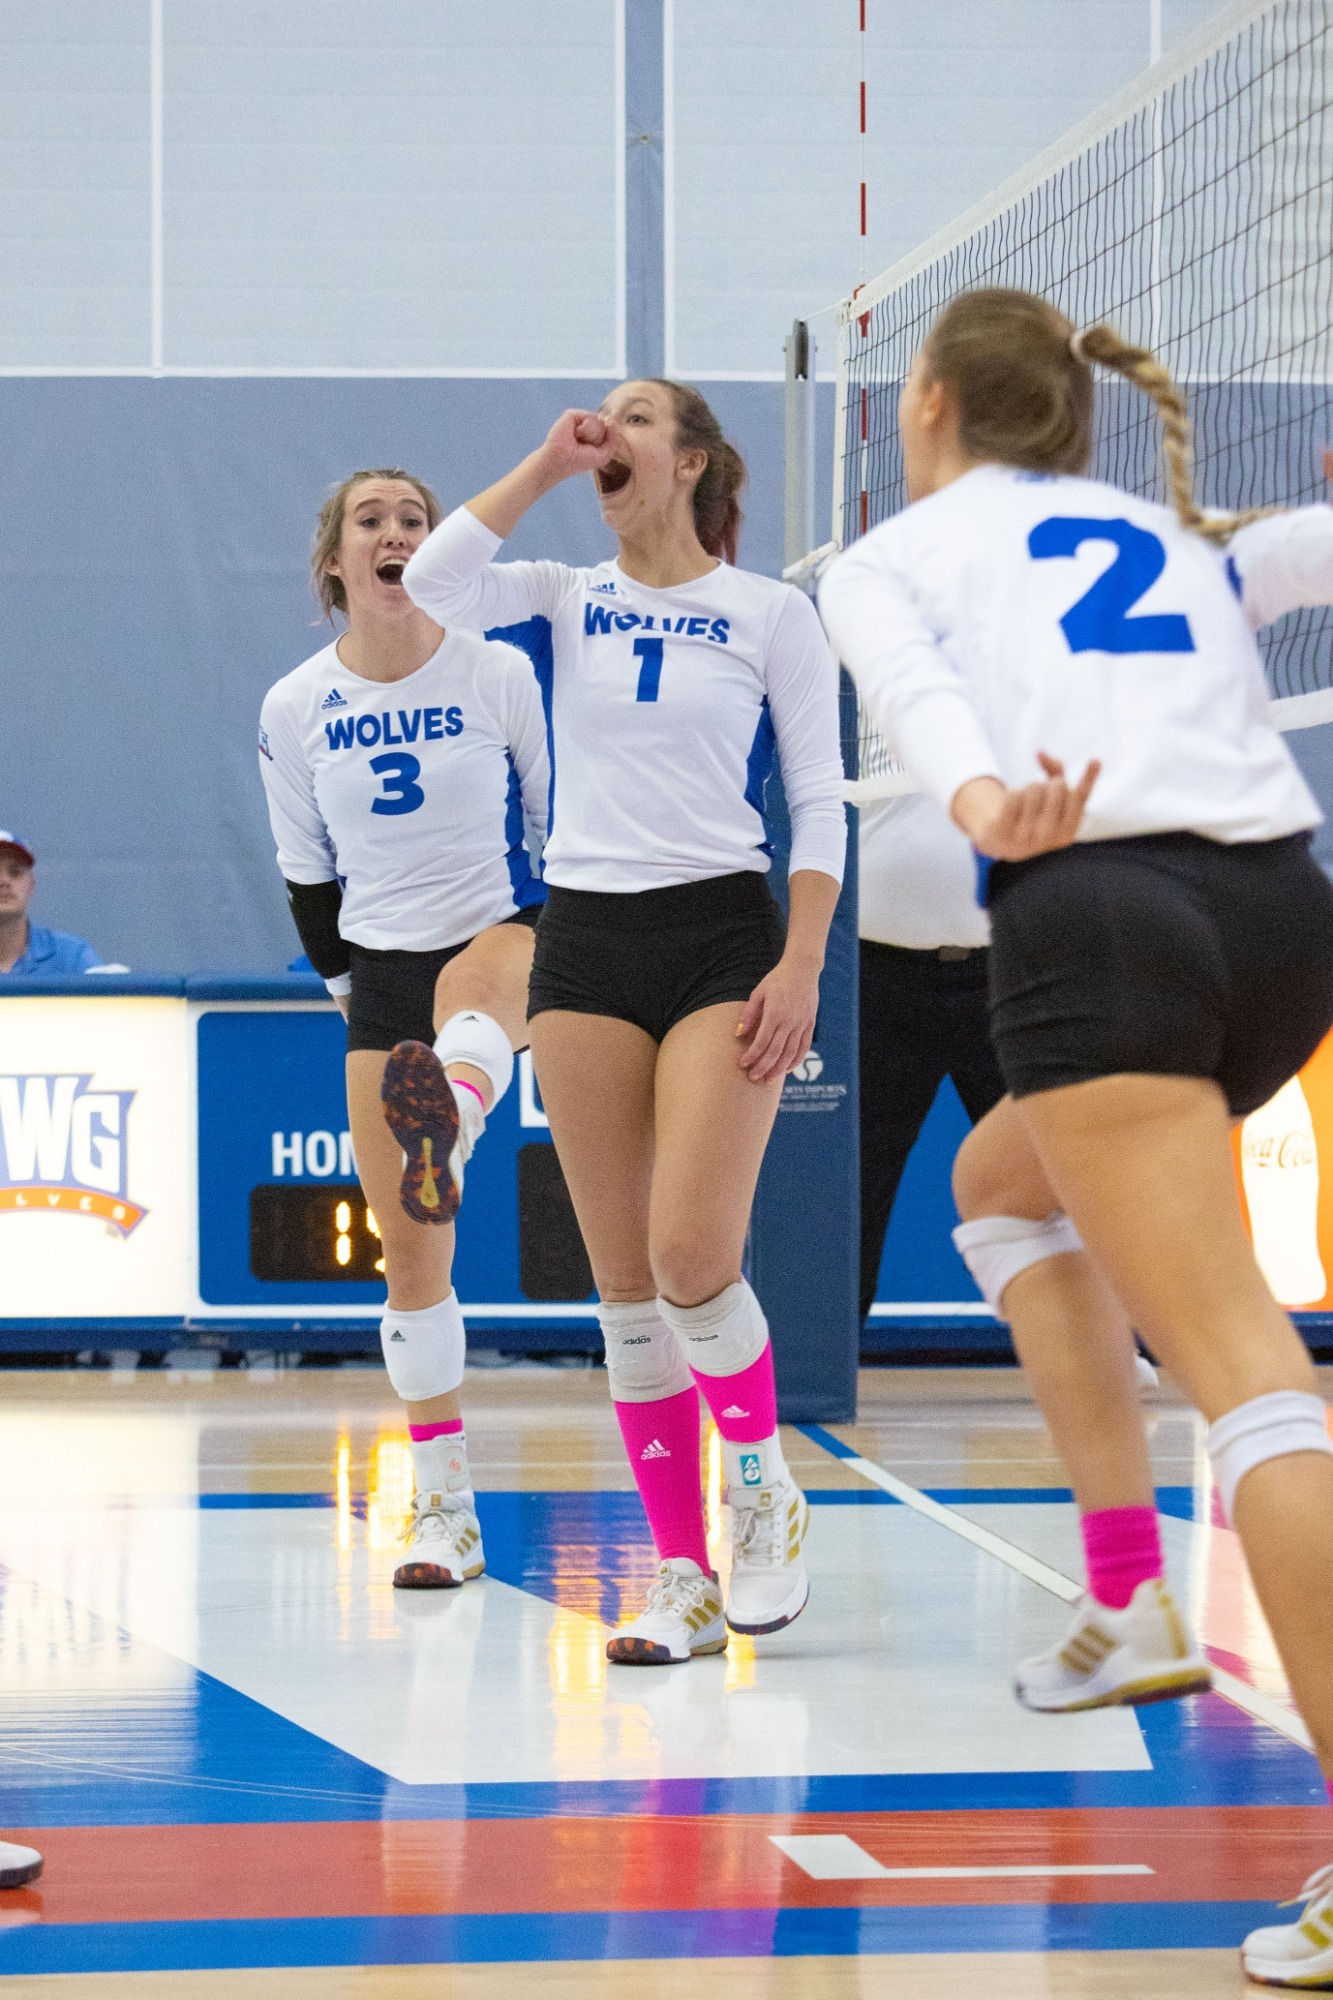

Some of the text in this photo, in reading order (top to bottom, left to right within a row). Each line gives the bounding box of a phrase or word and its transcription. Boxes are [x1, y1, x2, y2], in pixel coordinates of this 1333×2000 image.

[1028, 516, 1196, 654] 2
[585, 602, 730, 644] WOLVES
[633, 638, 663, 702] 1
[321, 699, 348, 710] adidas
[325, 706, 464, 751] WOLVES
[369, 752, 425, 816] 3
[641, 1450, 671, 1460] adidas
